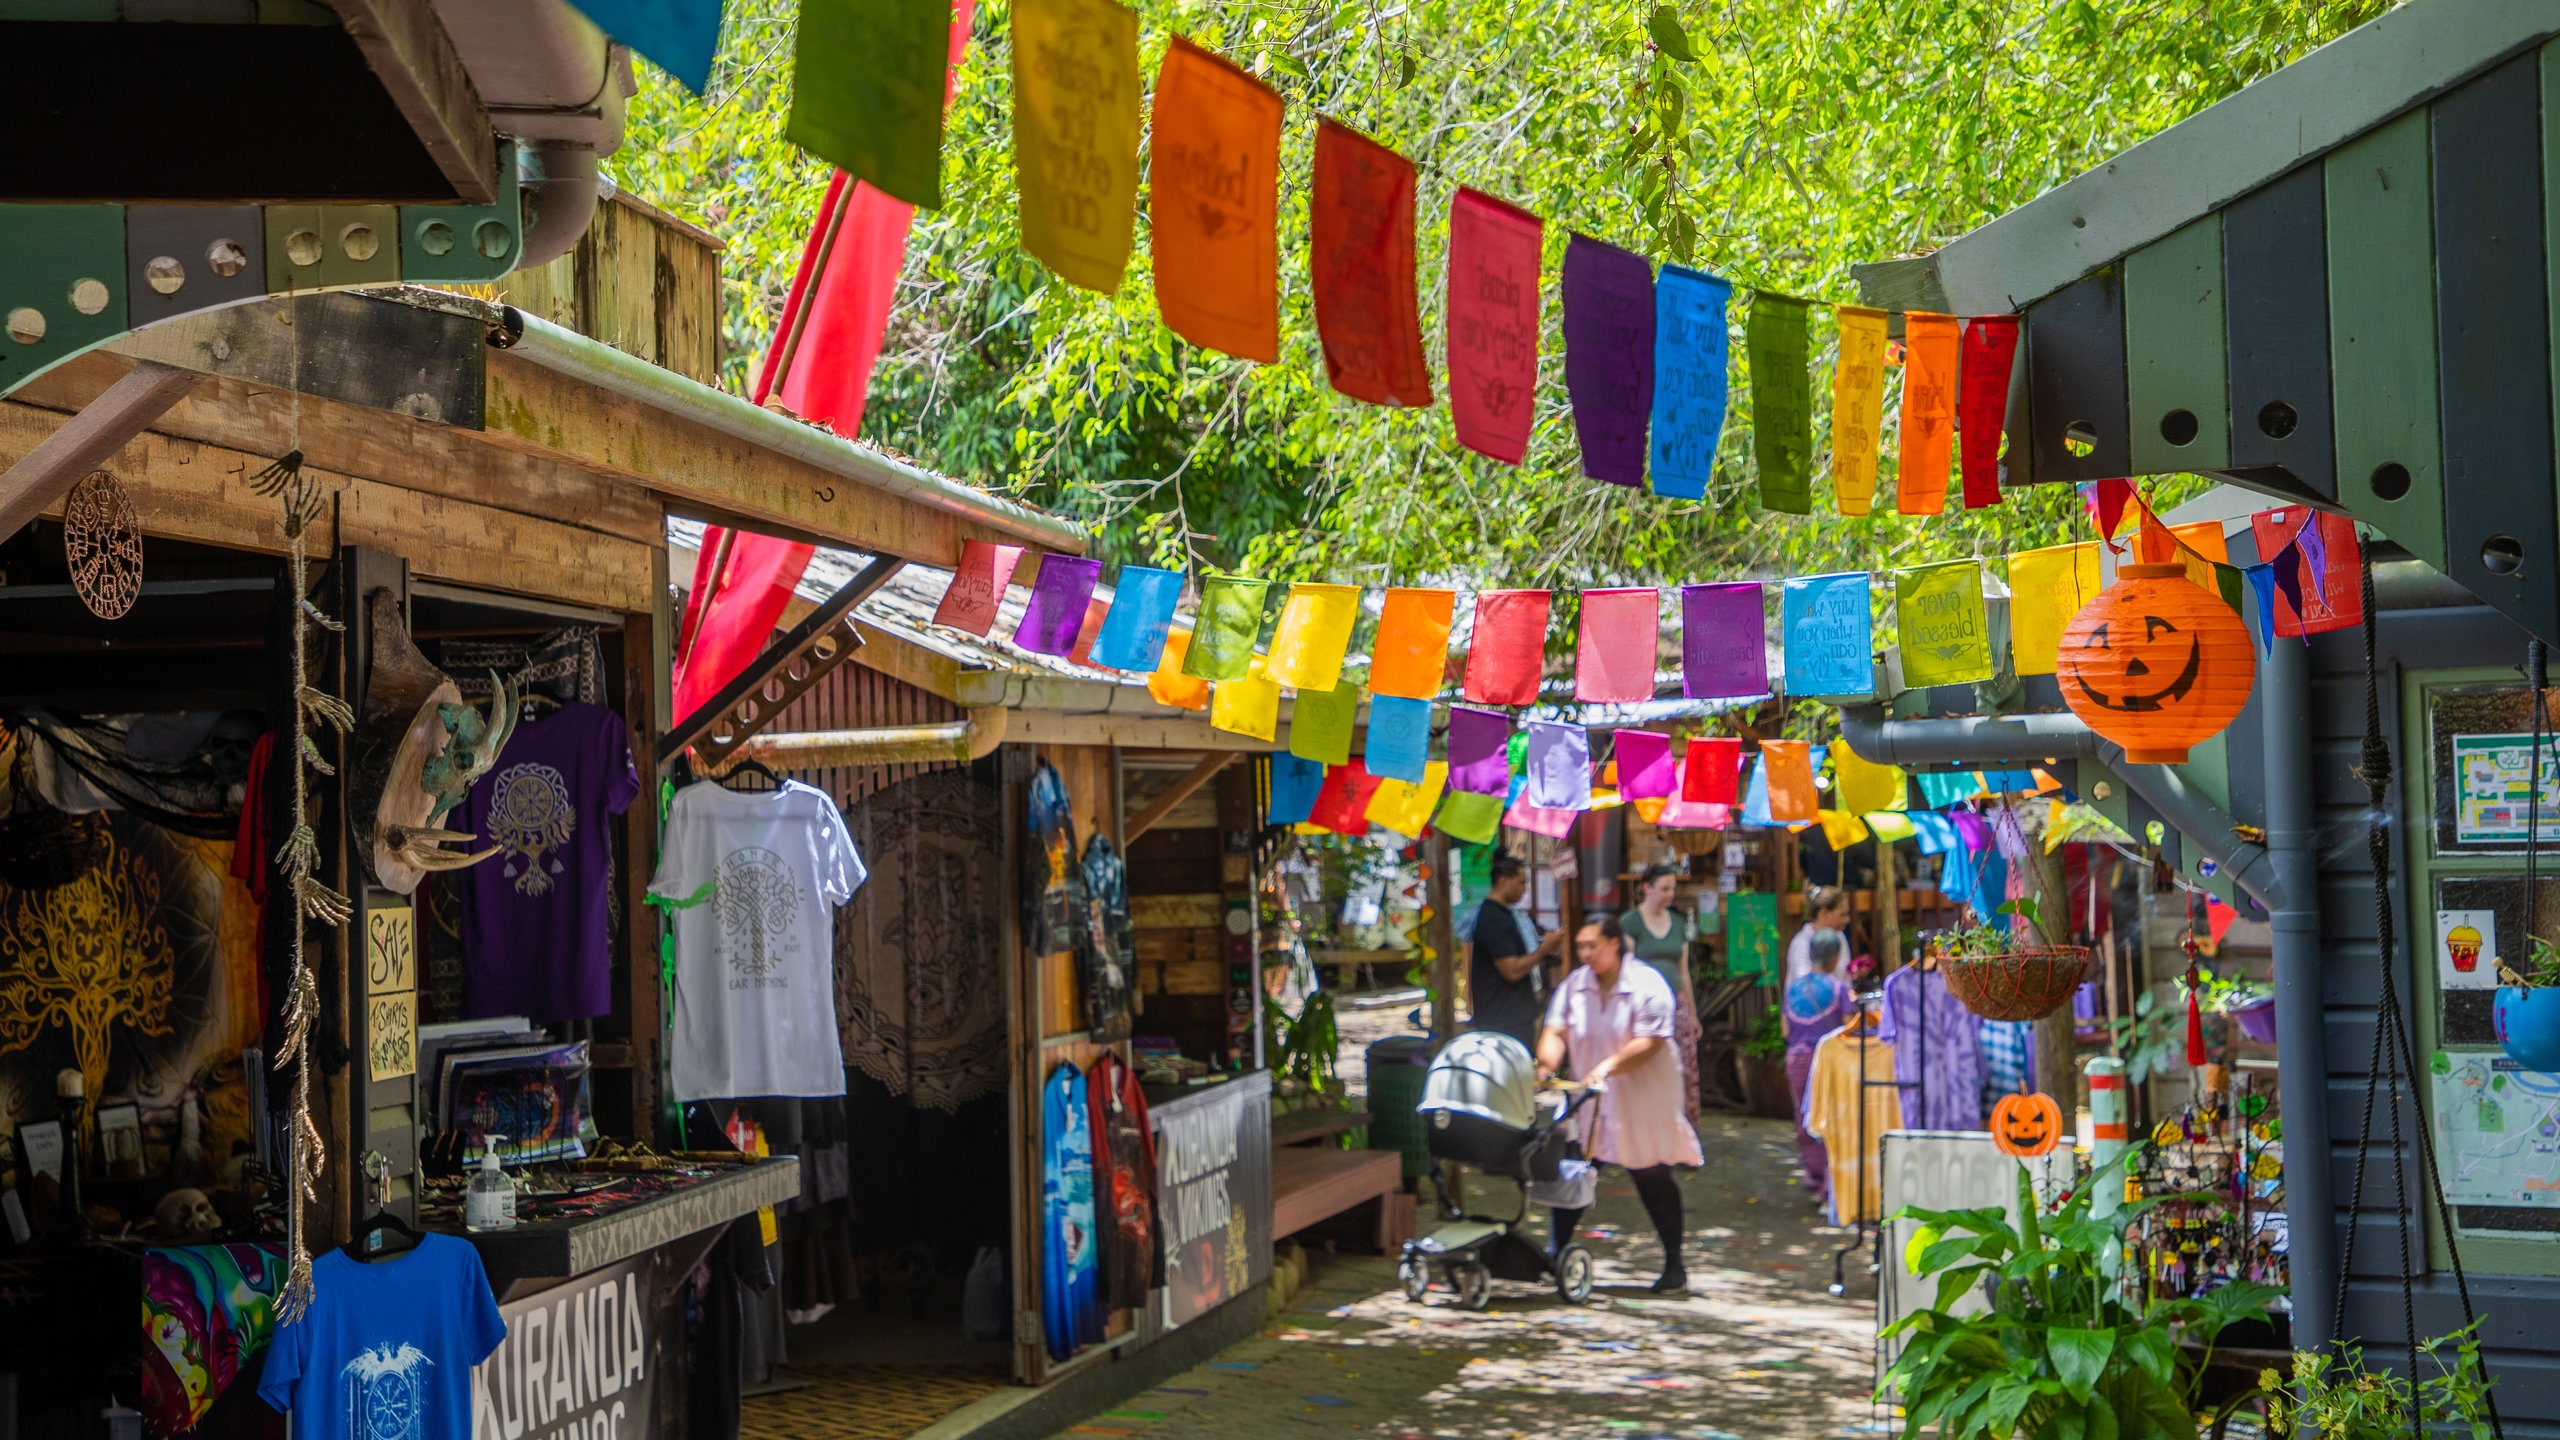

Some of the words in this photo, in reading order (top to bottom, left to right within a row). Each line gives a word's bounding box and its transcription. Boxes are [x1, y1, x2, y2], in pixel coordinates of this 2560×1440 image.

[726, 850, 781, 869] HONOR
[370, 913, 410, 987] SALE
[754, 976, 788, 989] NOTHING
[471, 1272, 644, 1440] KURANDA
